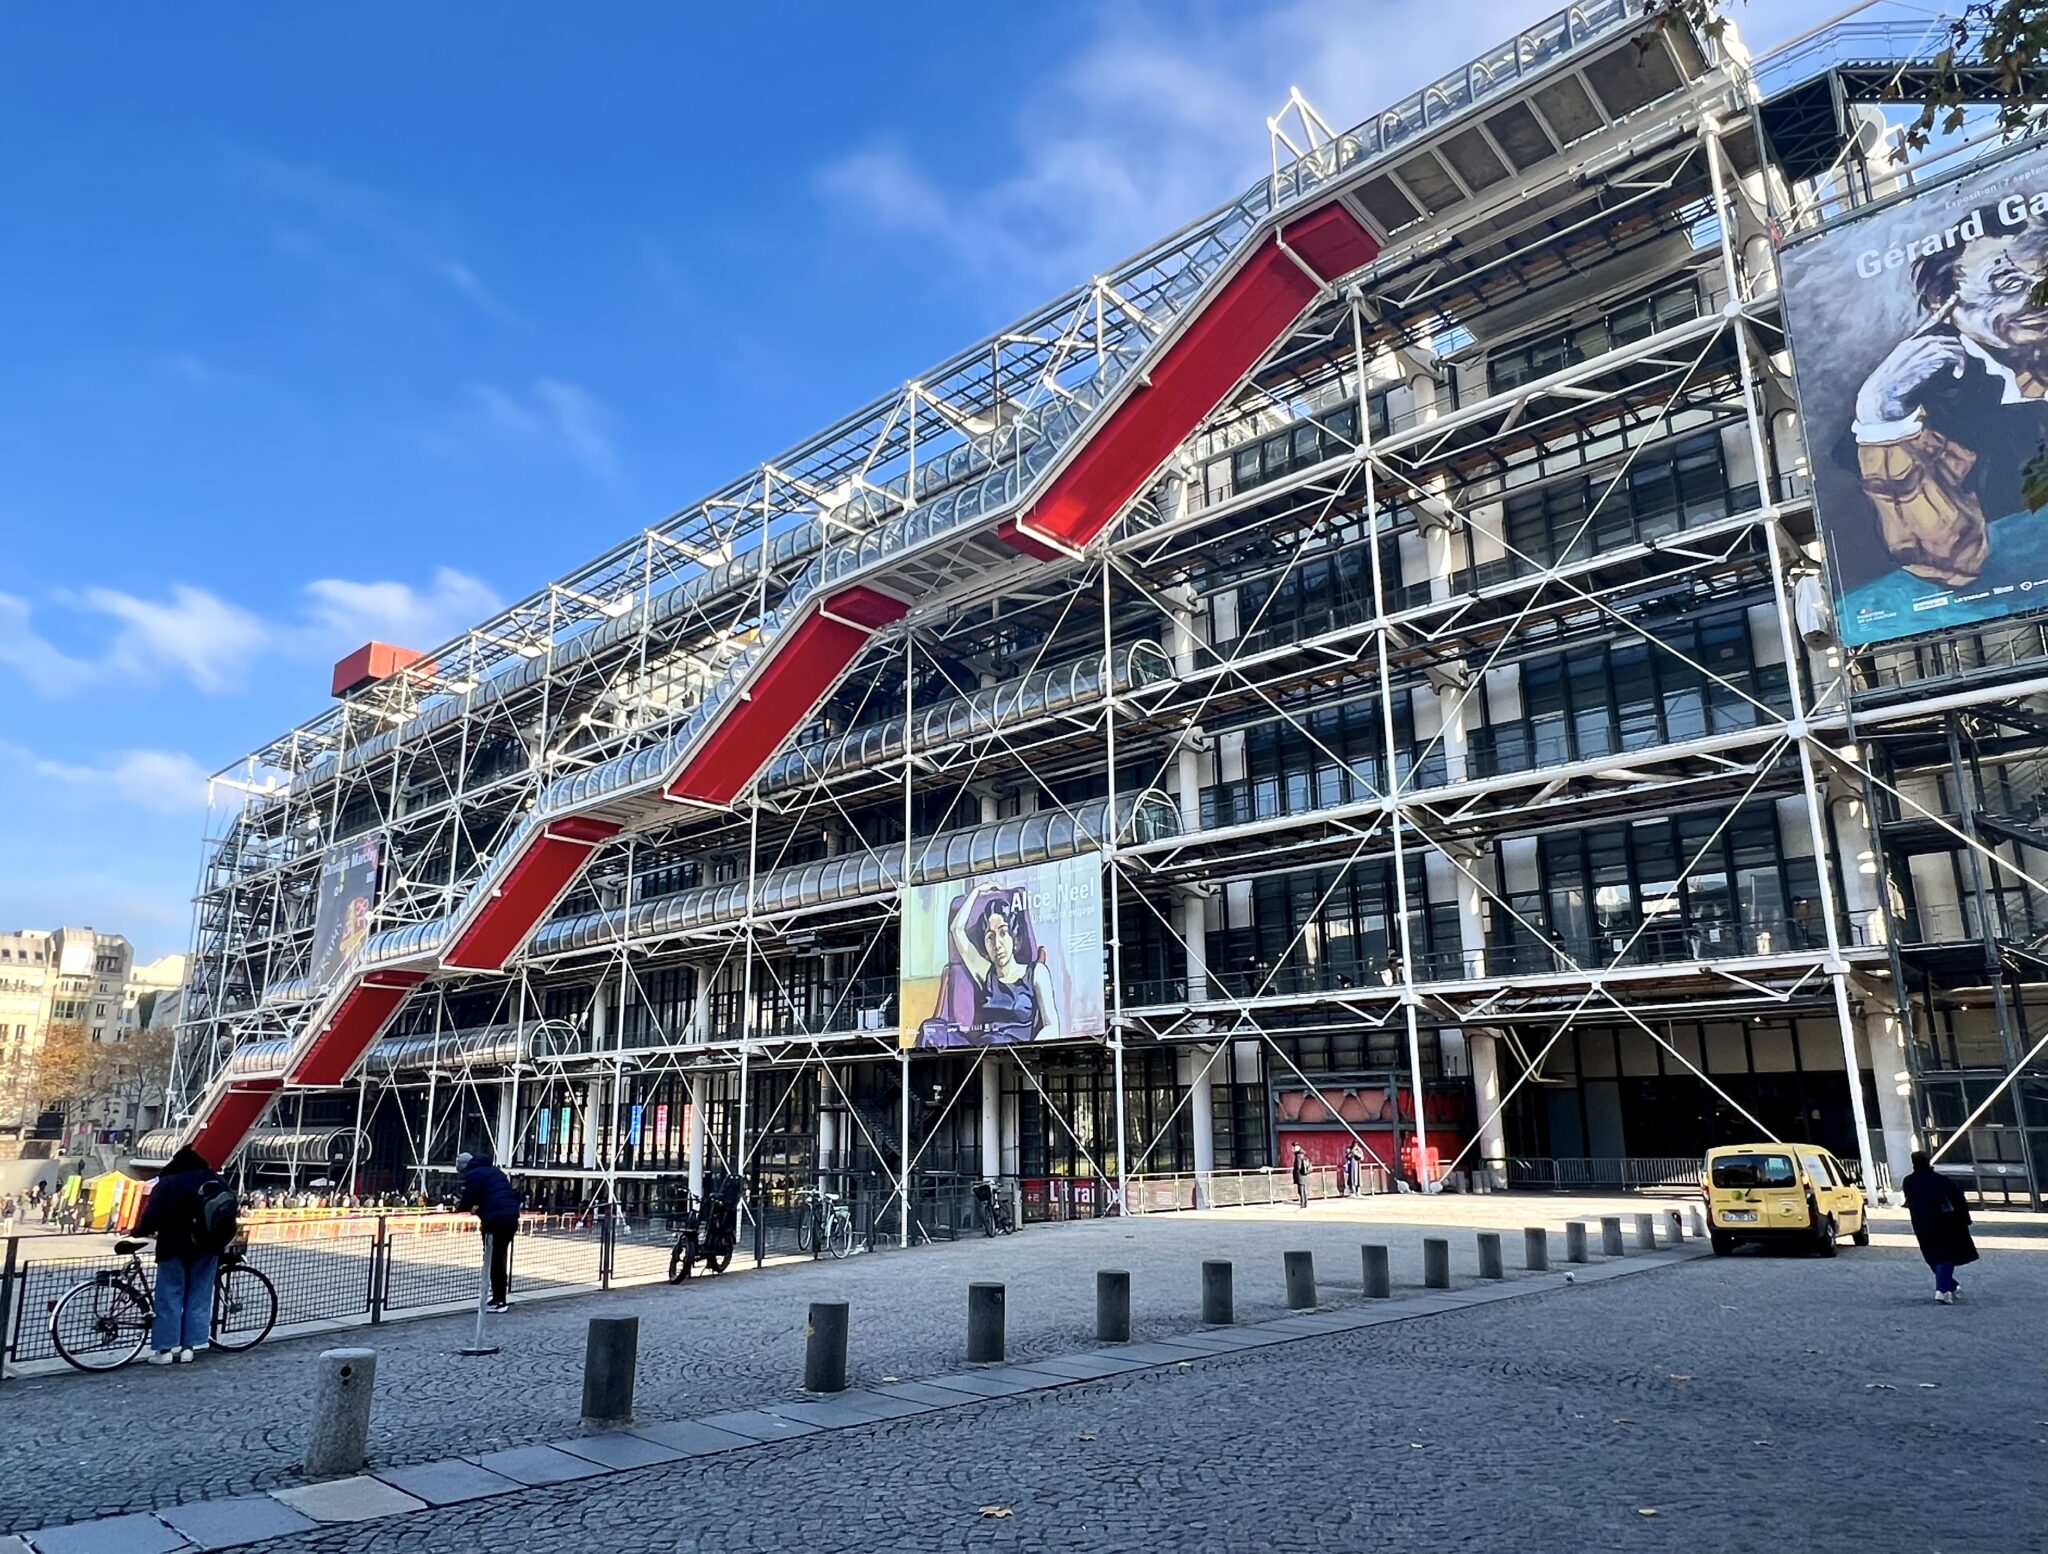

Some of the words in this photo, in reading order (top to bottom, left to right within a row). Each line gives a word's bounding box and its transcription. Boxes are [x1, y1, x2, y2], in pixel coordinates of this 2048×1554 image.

[1944, 184, 1997, 210] Exposition
[1856, 209, 1985, 279] Gérard
[1997, 191, 2048, 226] Ga
[1011, 890, 1051, 912] Alice
[1057, 877, 1095, 904] Neel
